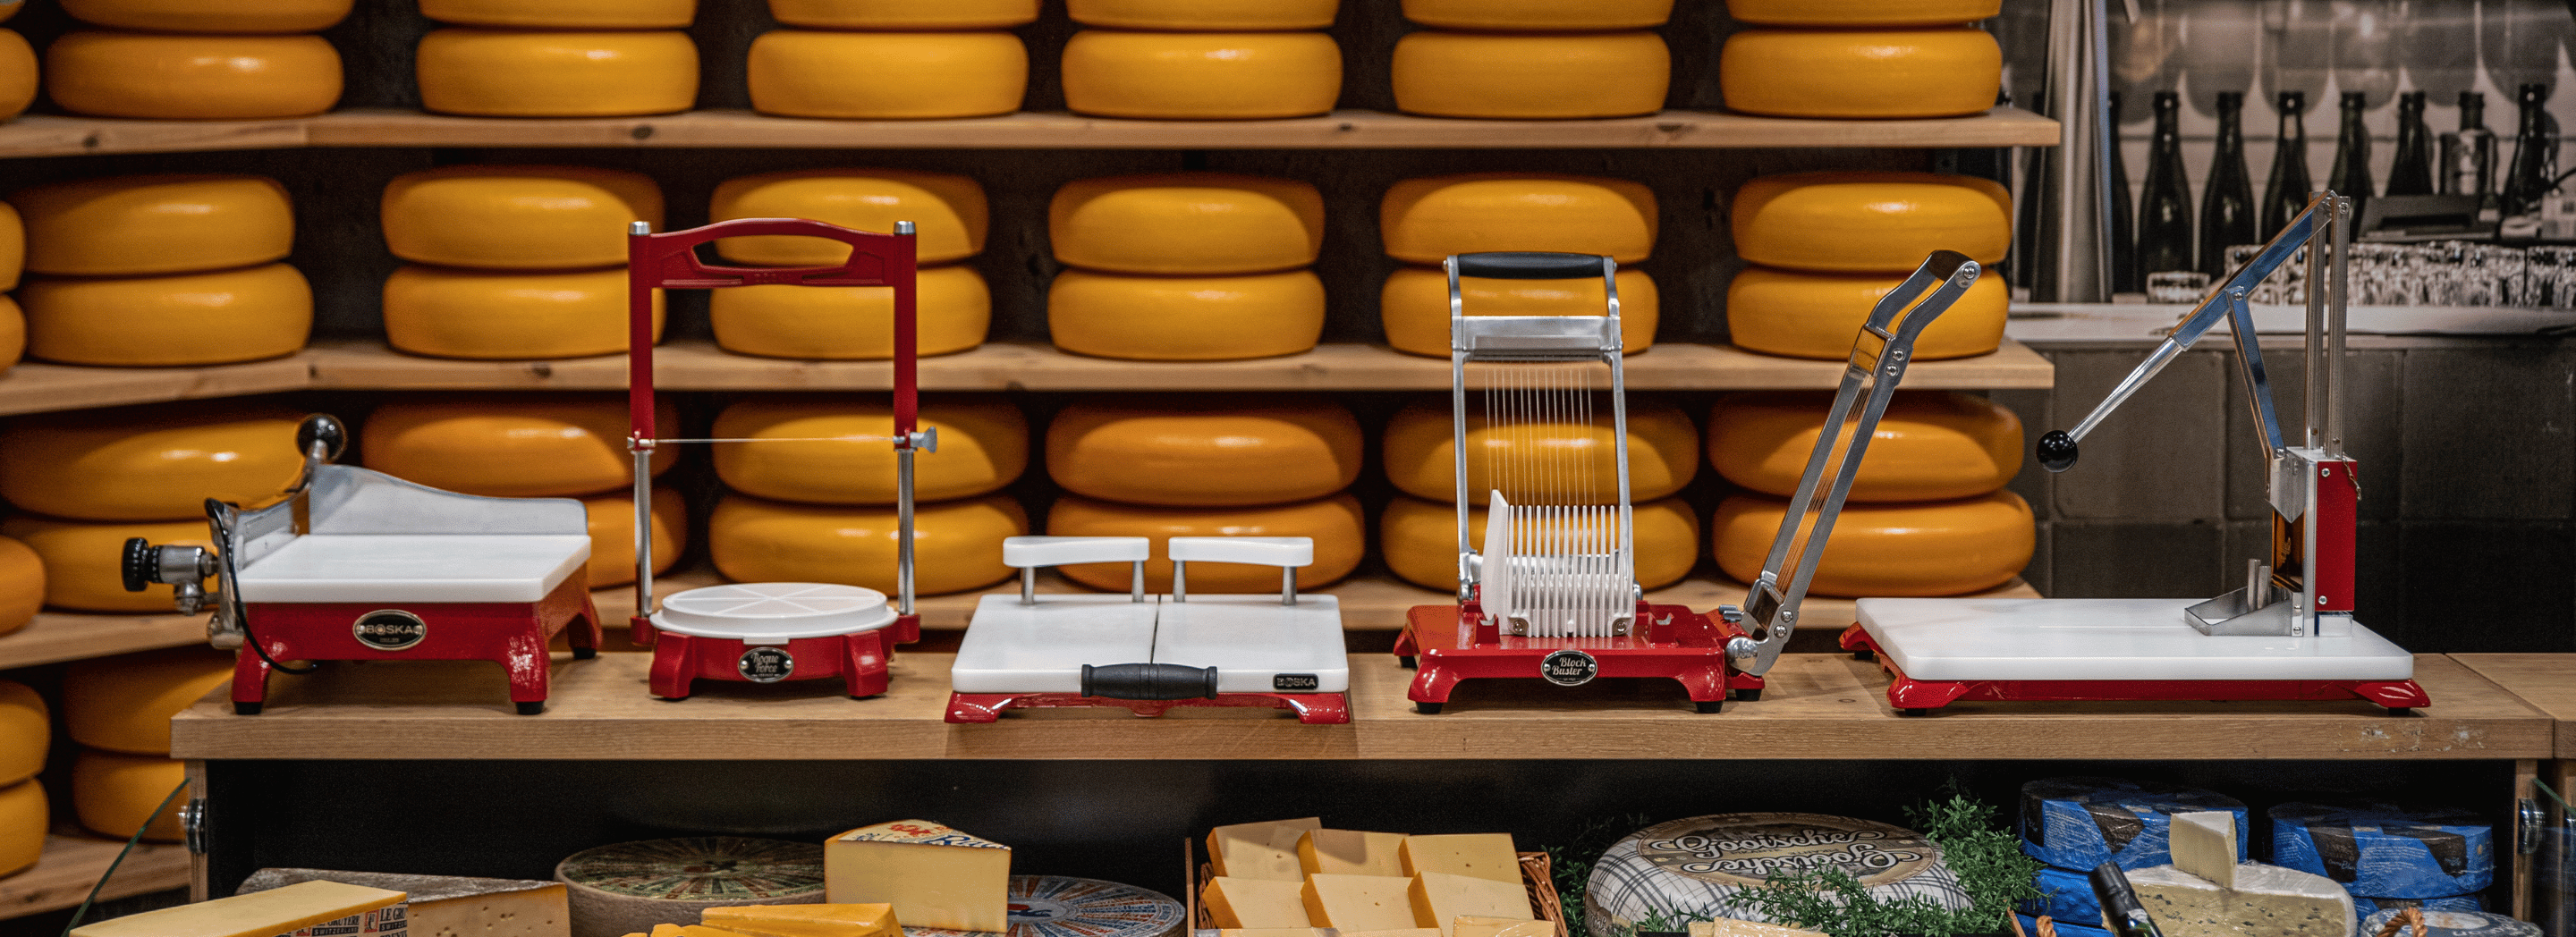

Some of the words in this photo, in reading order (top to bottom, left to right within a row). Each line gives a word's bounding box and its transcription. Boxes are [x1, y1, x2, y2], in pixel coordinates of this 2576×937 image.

[366, 624, 413, 636] BOSKA
[755, 662, 777, 672] Force
[1559, 657, 1587, 667] Block
[1552, 665, 1582, 675] Buster
[1276, 677, 1317, 688] BOSKA
[1650, 830, 1885, 858] Gooische
[1682, 843, 1920, 874] Gooische
[380, 908, 392, 921] LE
